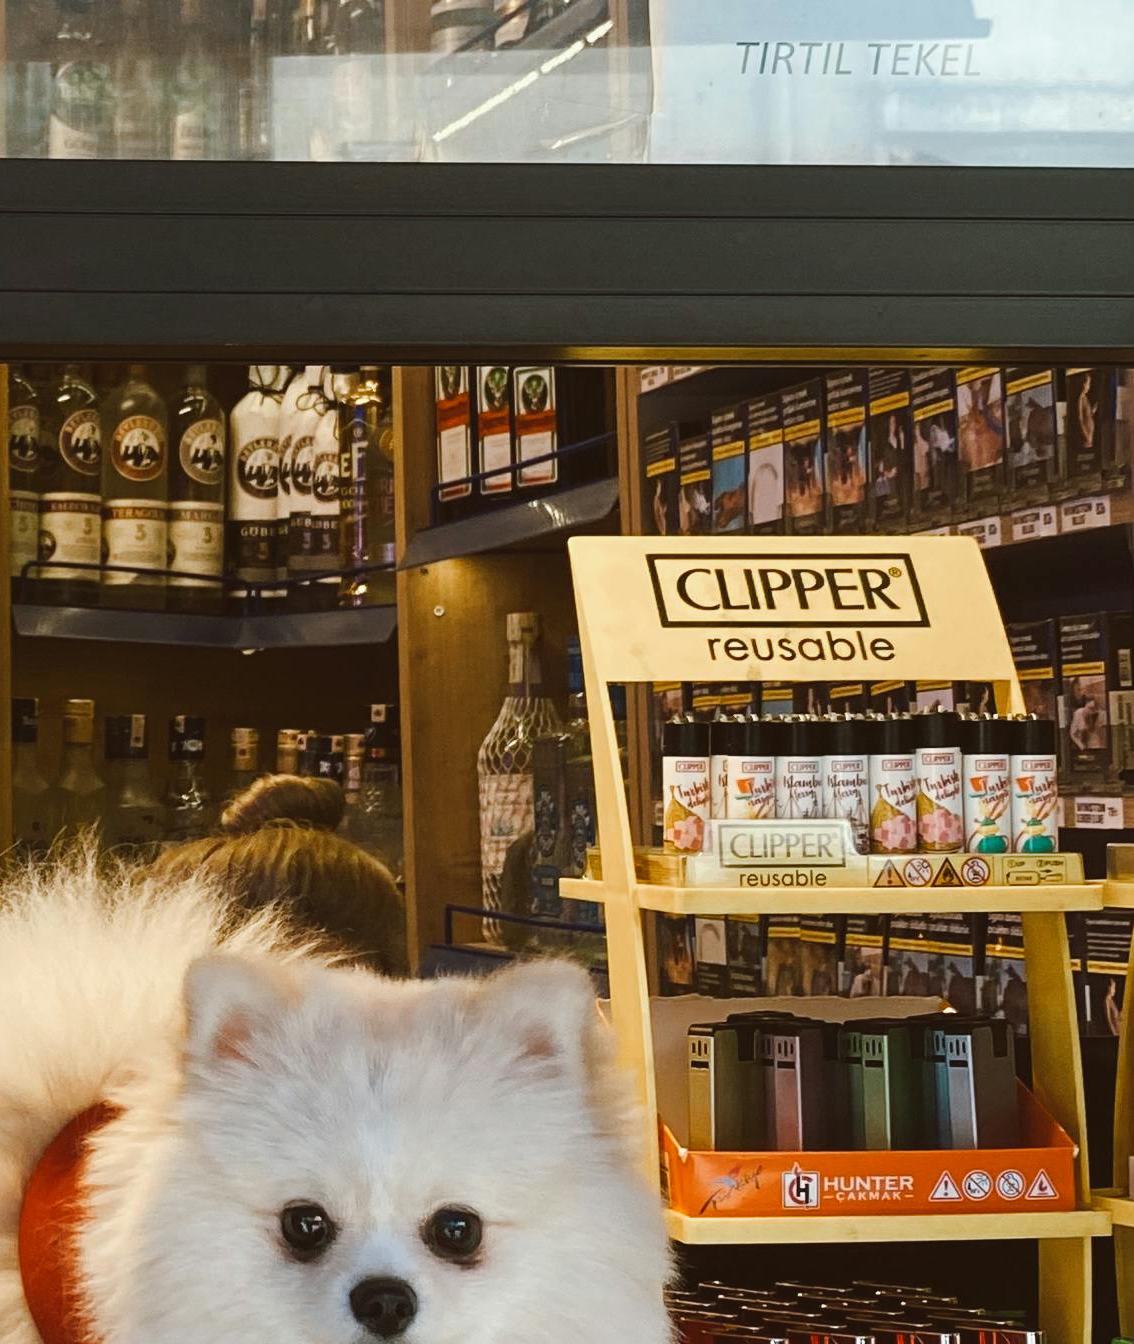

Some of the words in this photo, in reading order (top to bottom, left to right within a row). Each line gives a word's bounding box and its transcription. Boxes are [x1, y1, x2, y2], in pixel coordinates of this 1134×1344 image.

[737, 41, 855, 76] TIRTIL
[867, 41, 982, 78] TEKEL
[676, 567, 901, 612] CLIPPER
[706, 629, 896, 663] reusable
[730, 833, 834, 859] CLIPPER
[739, 869, 827, 887] reusable
[823, 1175, 914, 1192] HUNTER
[836, 1192, 901, 1203] ÇAKMAK
